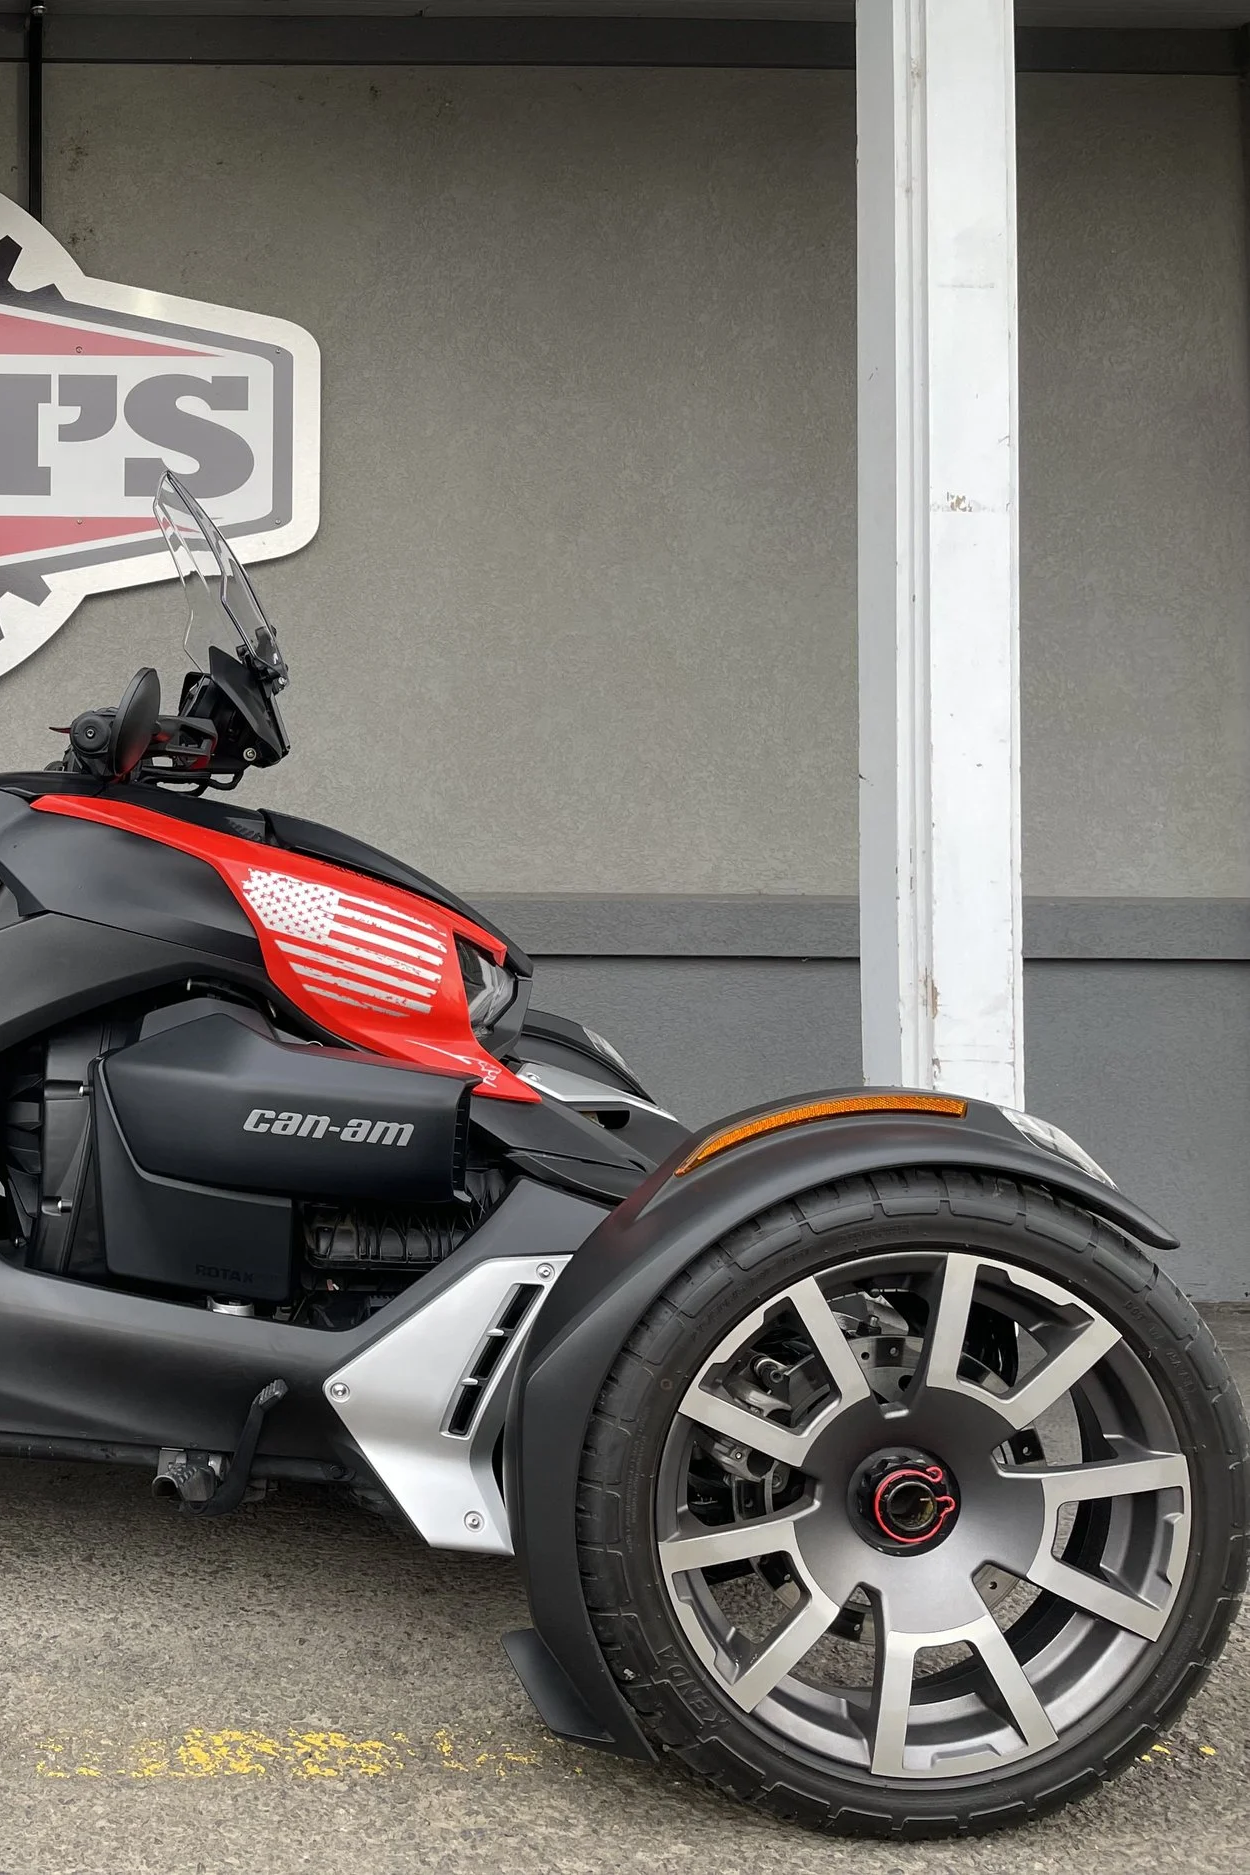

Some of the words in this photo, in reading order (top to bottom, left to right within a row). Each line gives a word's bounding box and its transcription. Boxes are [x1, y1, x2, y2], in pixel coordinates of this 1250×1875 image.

[243, 1108, 415, 1147] can-am
[194, 1263, 255, 1285] ROTAX
[656, 1643, 732, 1730] KENDA
